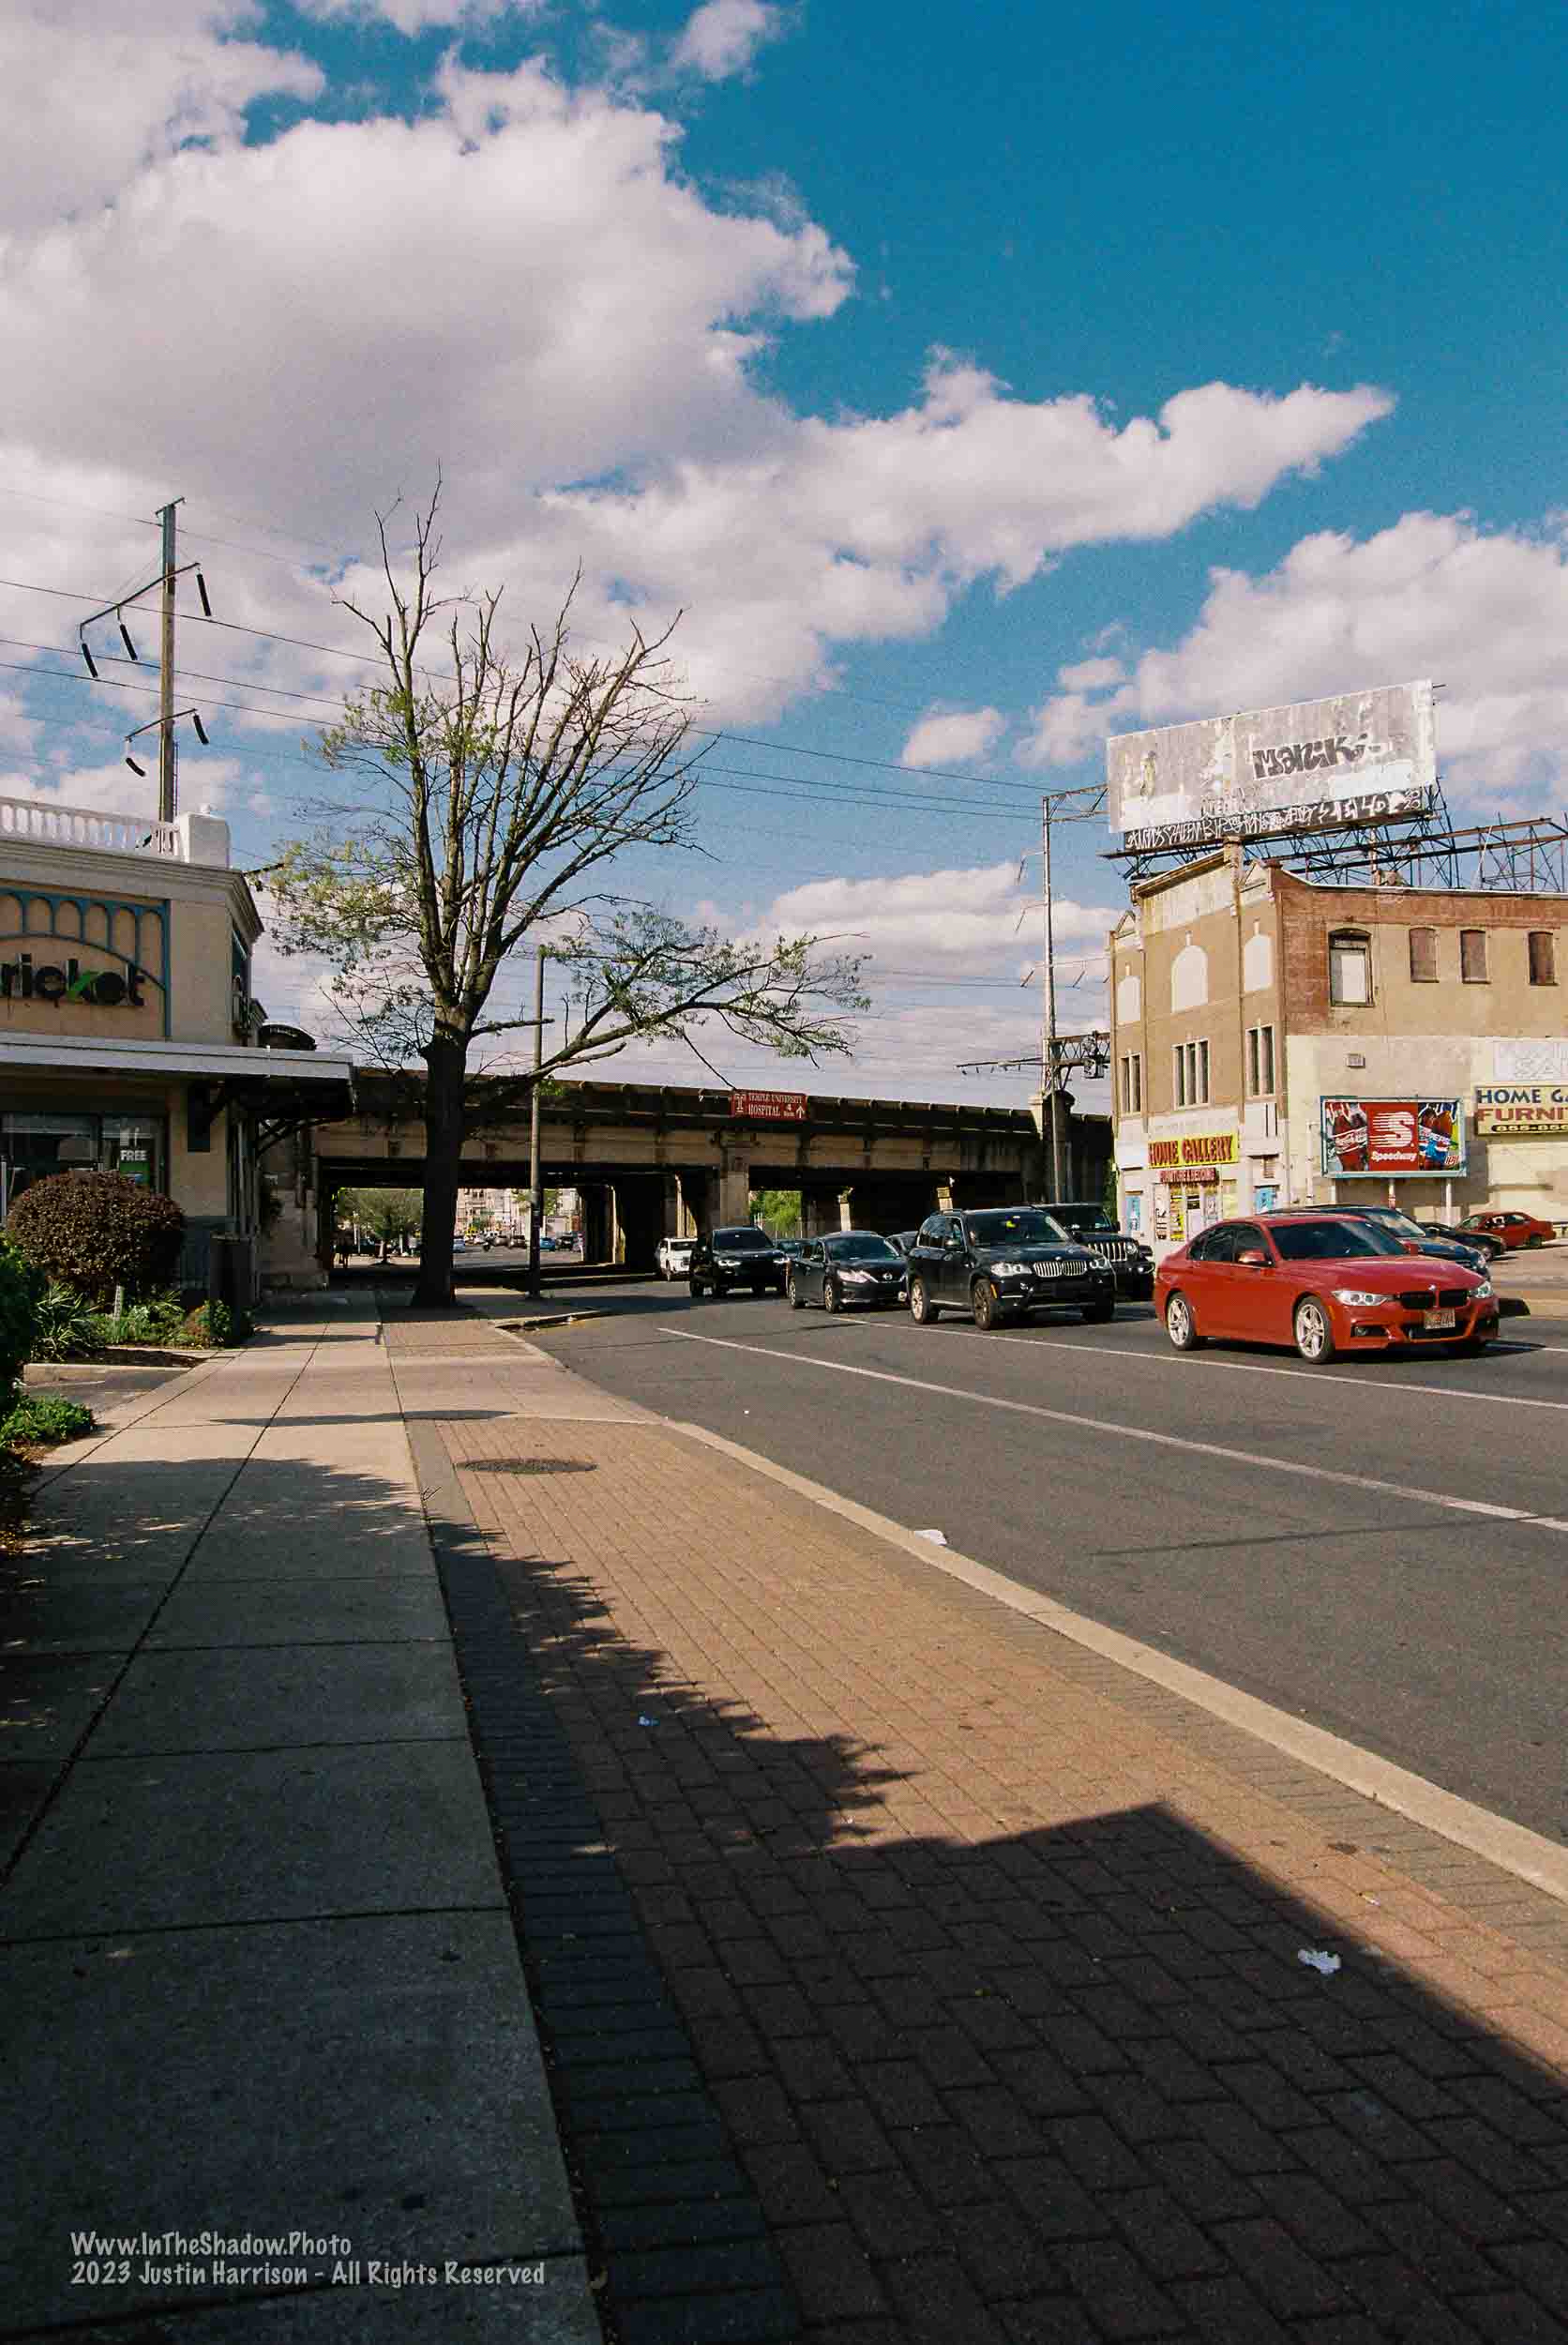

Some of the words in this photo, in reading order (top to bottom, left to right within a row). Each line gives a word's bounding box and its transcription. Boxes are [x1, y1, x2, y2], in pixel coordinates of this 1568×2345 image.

[1476, 1089, 1541, 1103] HOME
[748, 1103, 781, 1116] HOSPITAL
[120, 1149, 147, 1161] FREE
[1149, 1141, 1179, 1165] HOME
[1183, 1136, 1232, 1163] GALLERY
[1371, 1150, 1417, 1162] Speedway
